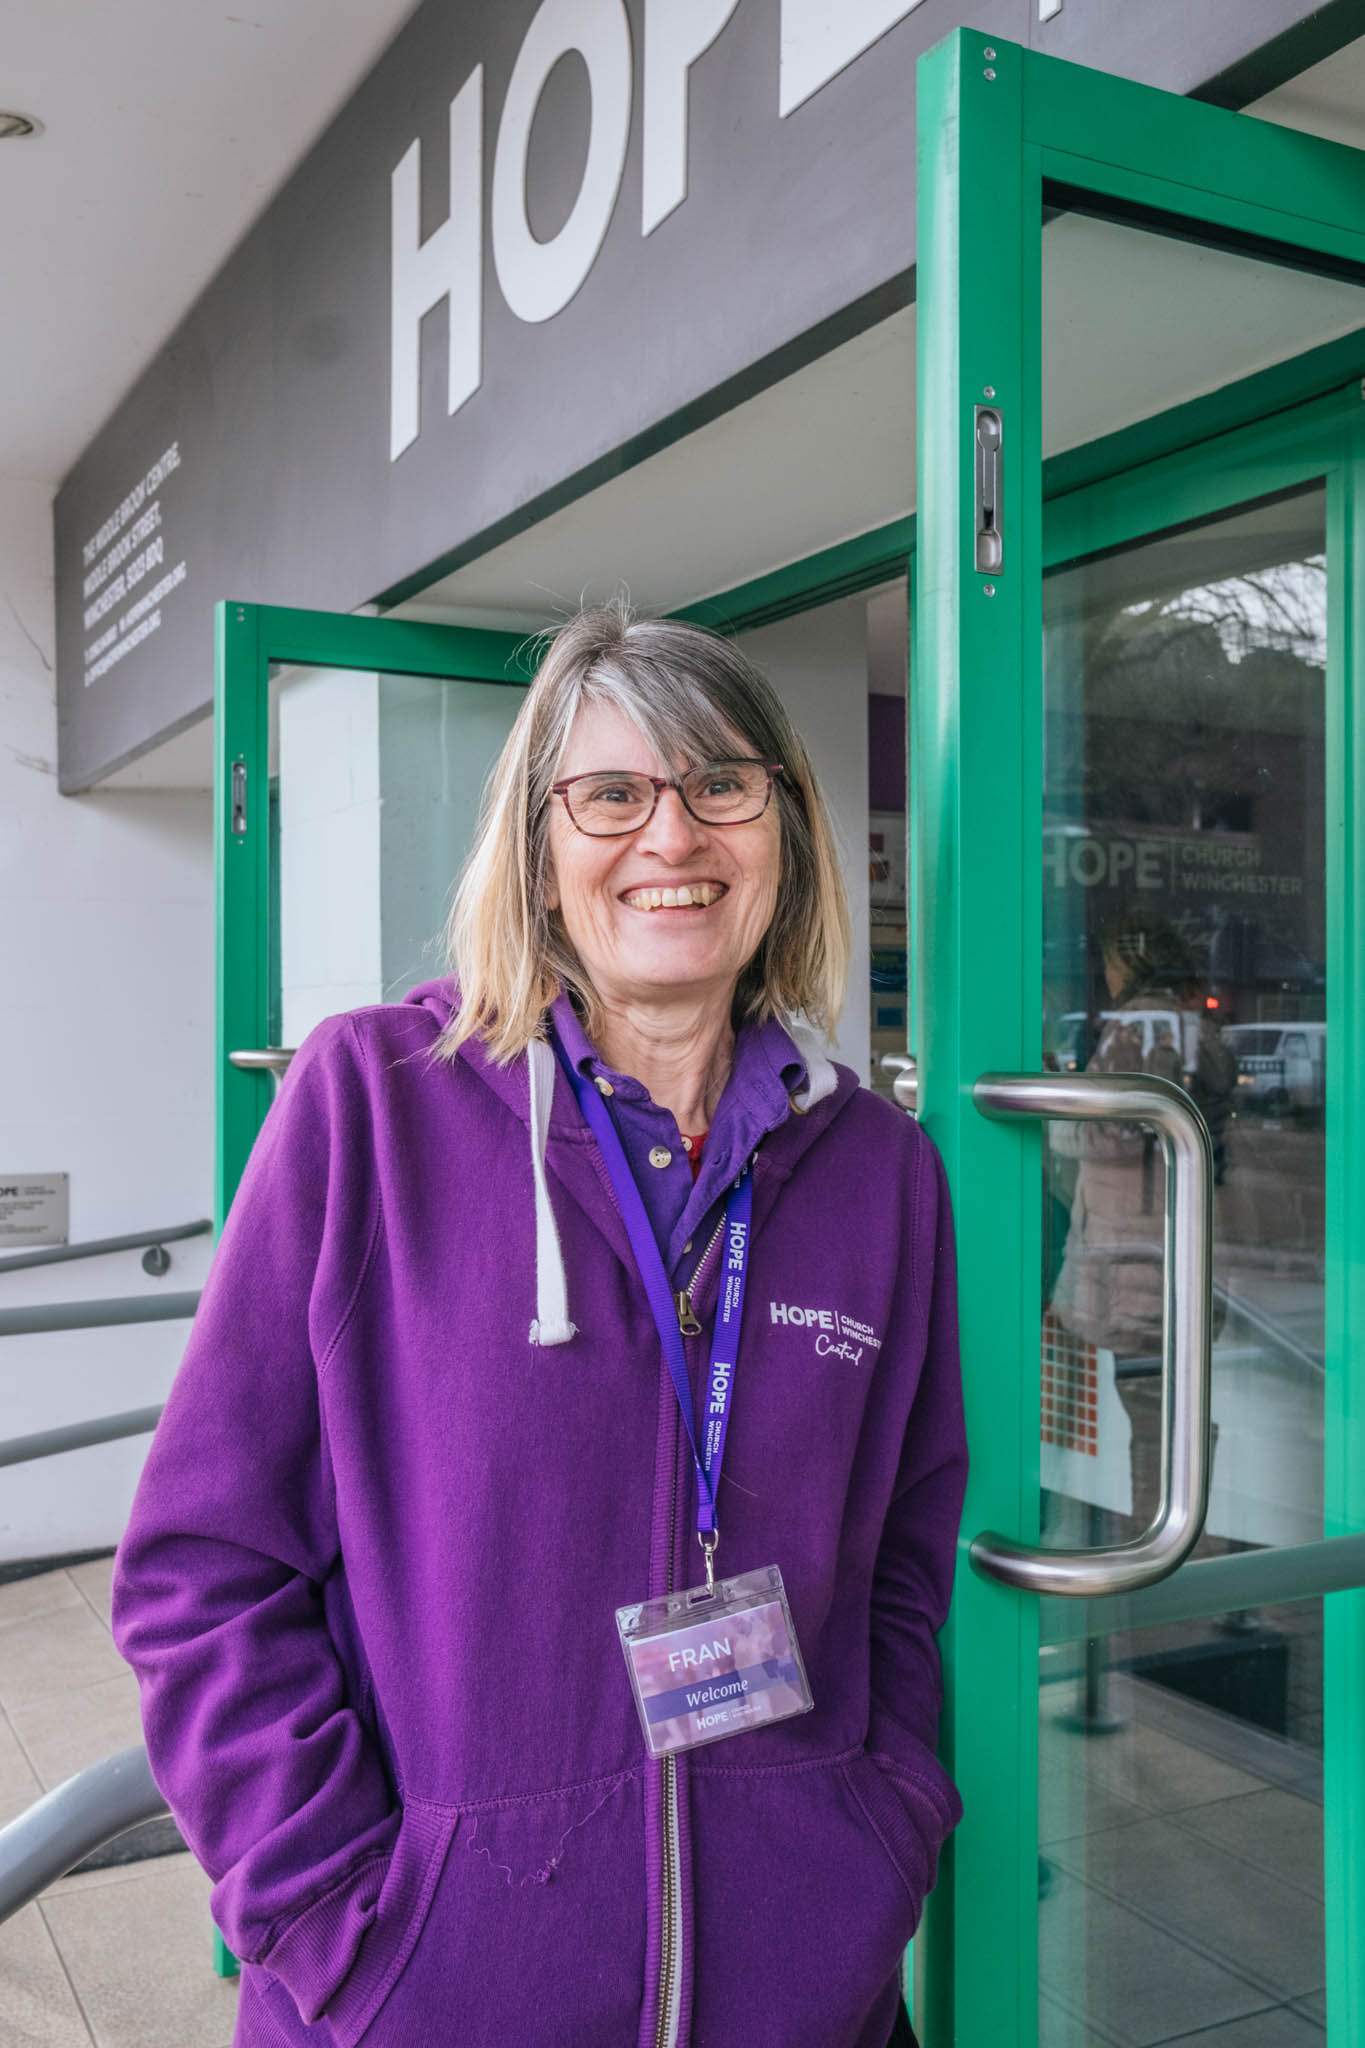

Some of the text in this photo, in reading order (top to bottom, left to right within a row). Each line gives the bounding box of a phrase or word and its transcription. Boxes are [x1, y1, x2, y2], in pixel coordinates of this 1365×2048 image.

[1182, 845, 1259, 867] CHURCH
[1182, 872, 1300, 895] WINCHESTER
[728, 1222, 747, 1270] HOPE
[723, 1276, 733, 1323] WINCHESTER
[732, 1277, 741, 1308] CHURCH
[770, 1302, 834, 1330] HOPE
[841, 1315, 874, 1335] CHURCH
[710, 1362, 731, 1414] HOPE
[705, 1421, 715, 1471] WINCHESTER
[712, 1421, 722, 1453] CHURCH
[668, 1637, 732, 1672] FRAN
[685, 1679, 748, 1707] Welcome
[696, 1711, 729, 1730] HOPE
